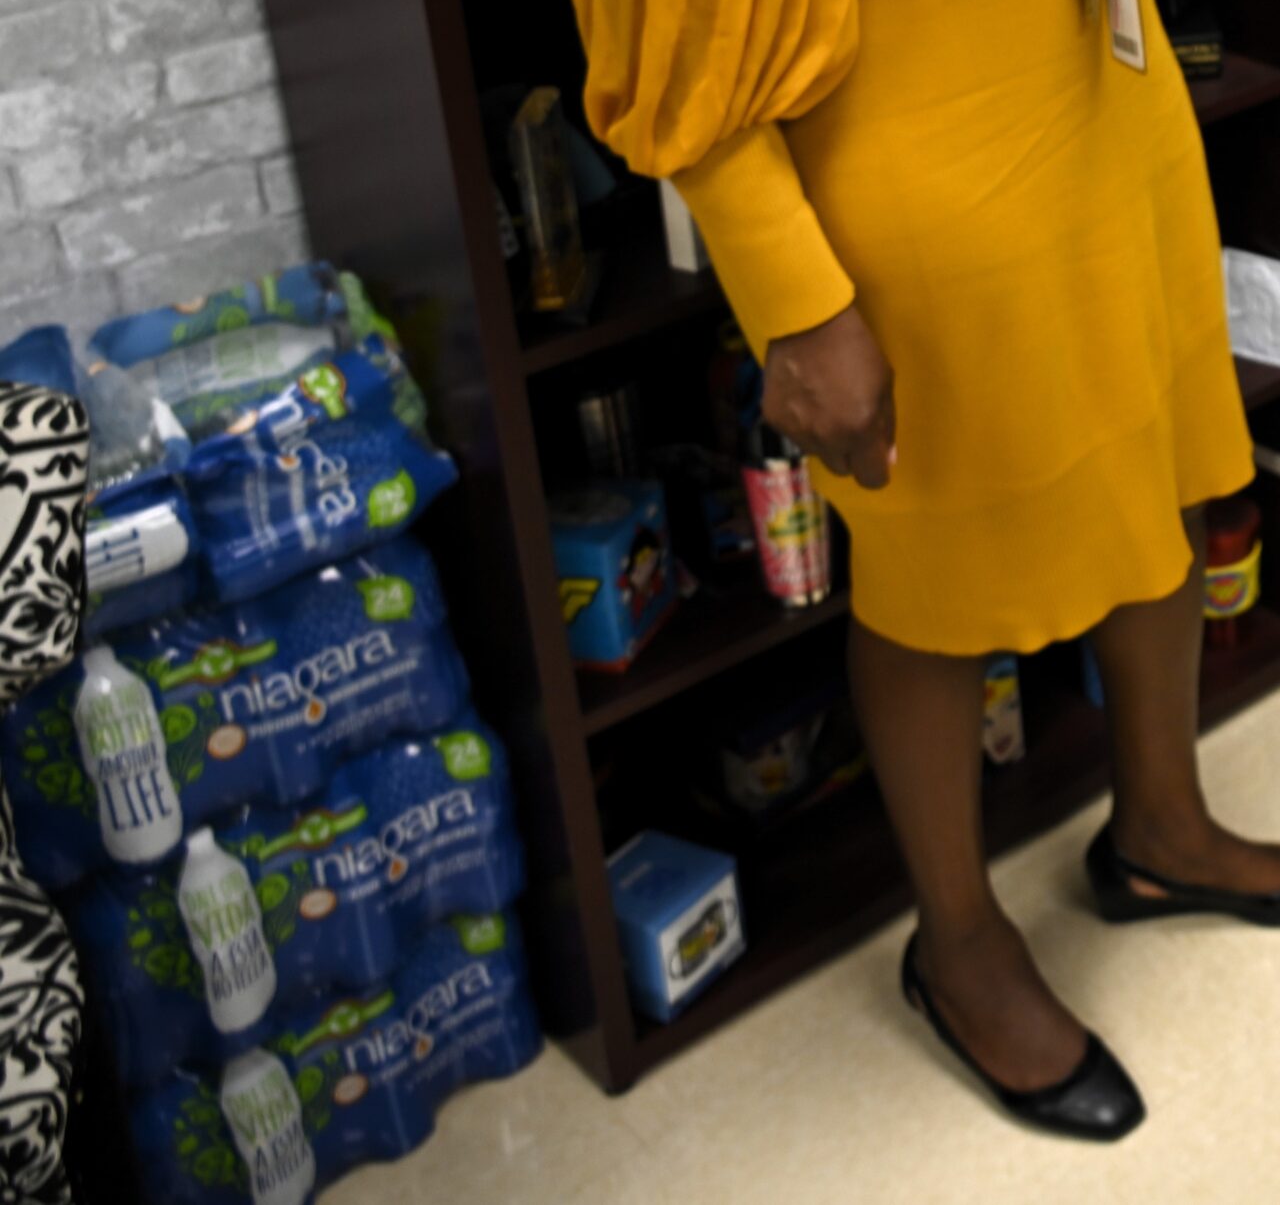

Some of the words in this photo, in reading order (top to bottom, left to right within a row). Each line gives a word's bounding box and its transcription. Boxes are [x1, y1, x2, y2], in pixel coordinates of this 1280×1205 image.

[220, 626, 399, 722] niagara
[103, 767, 172, 832] LIFE
[448, 740, 485, 766] 24
[314, 786, 477, 879] niagara
[345, 961, 494, 1070] niagara
